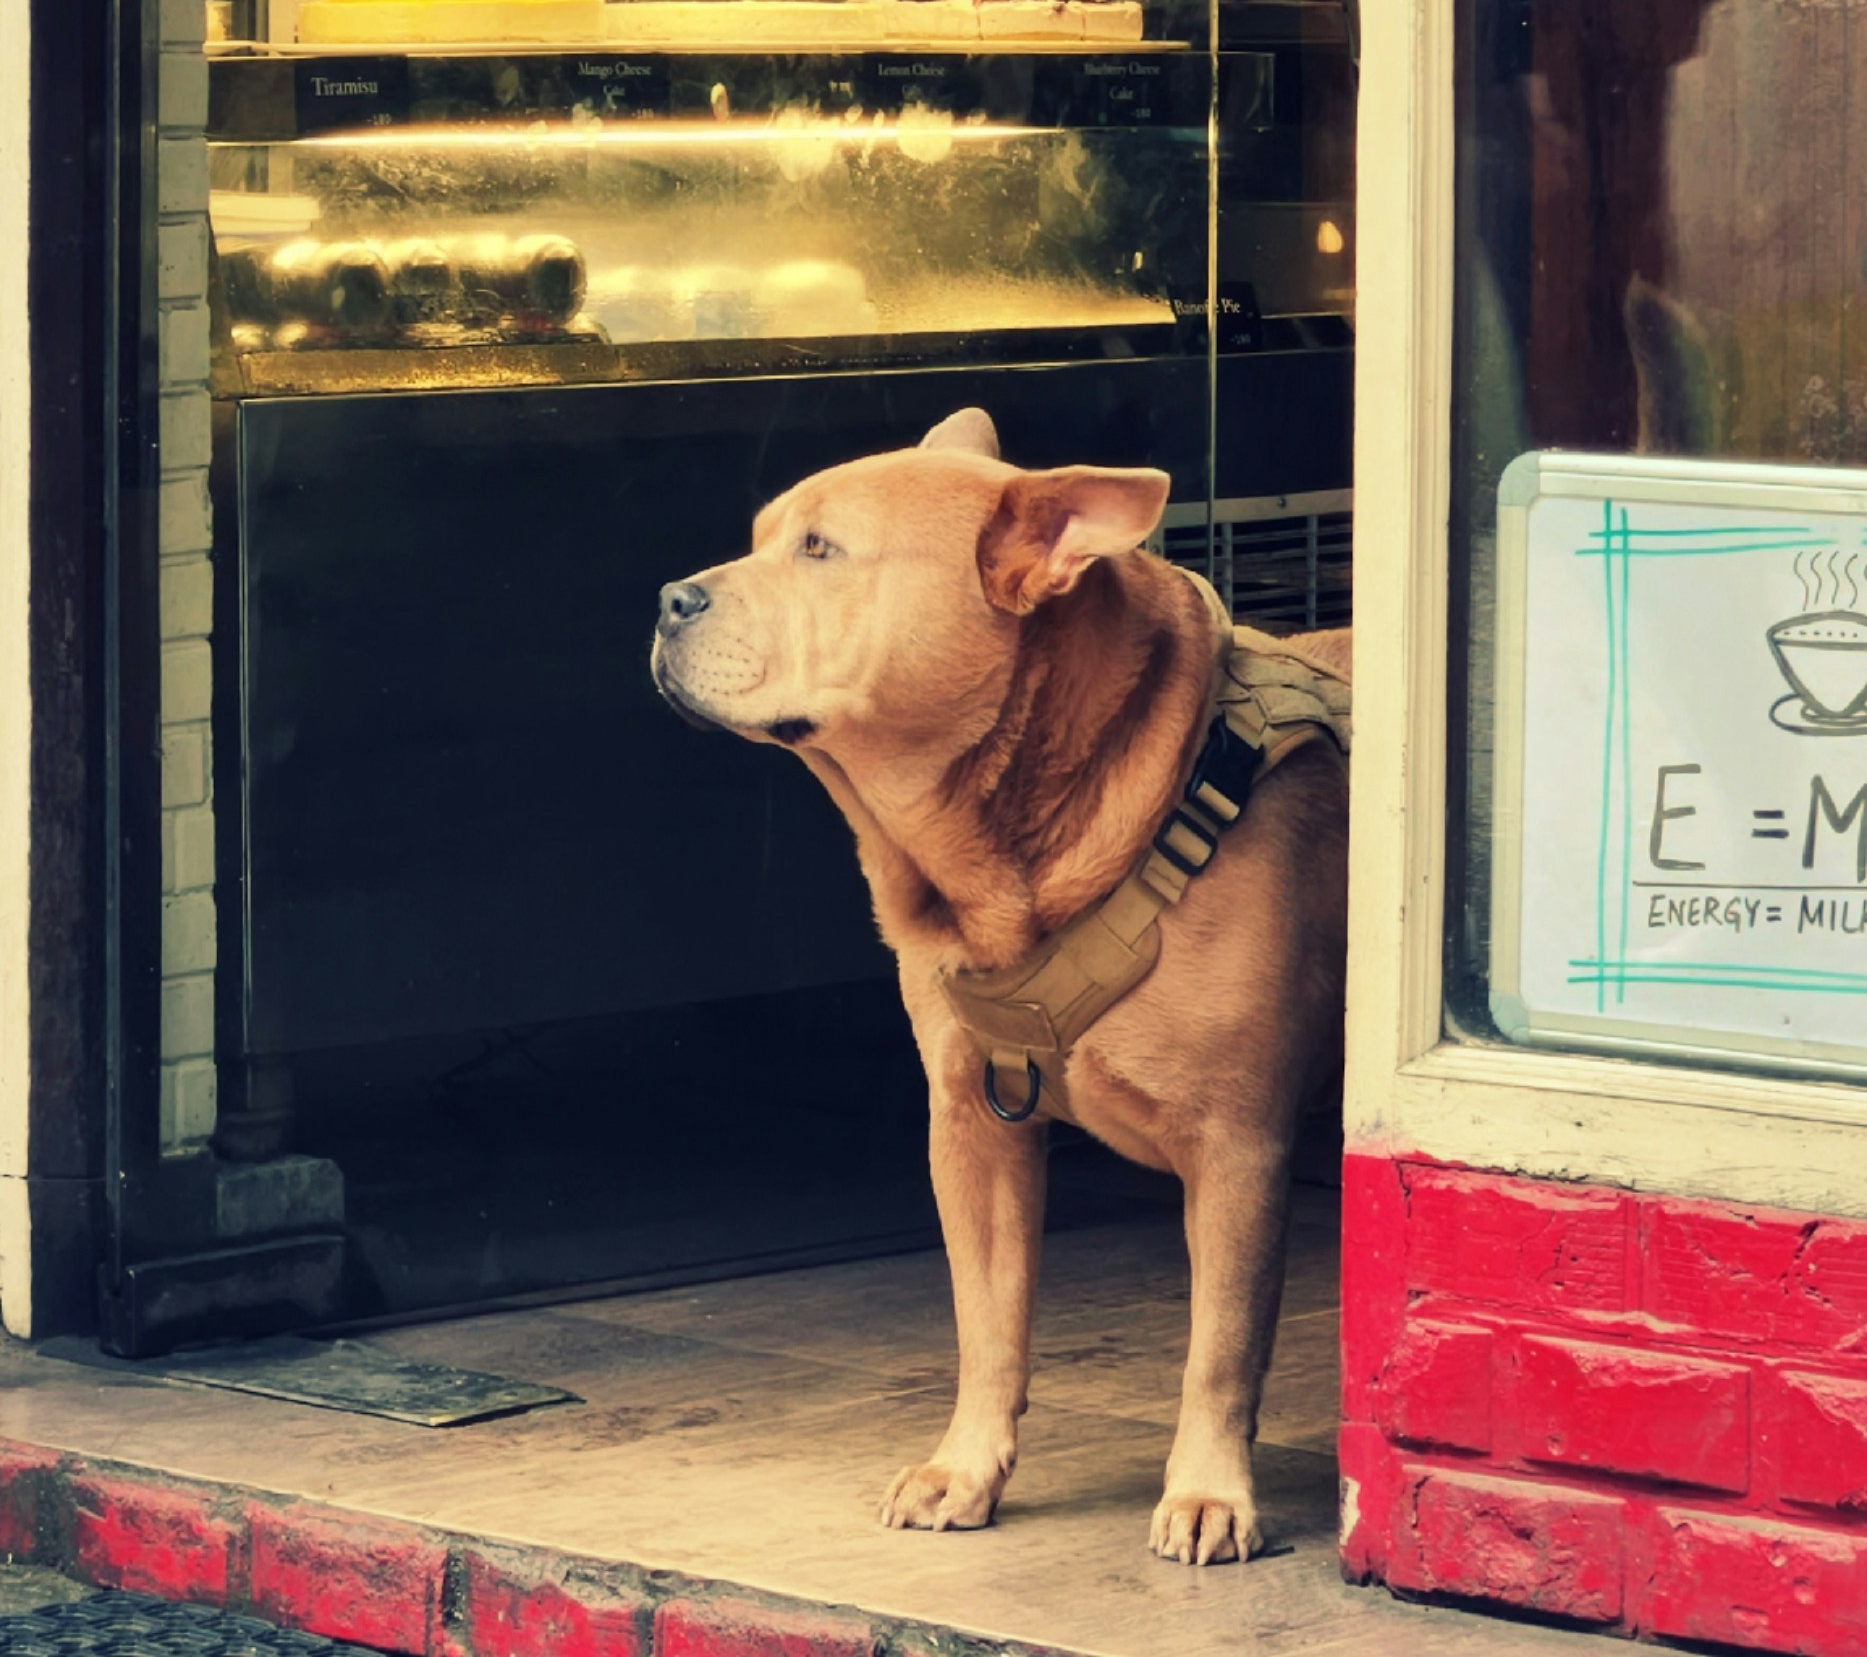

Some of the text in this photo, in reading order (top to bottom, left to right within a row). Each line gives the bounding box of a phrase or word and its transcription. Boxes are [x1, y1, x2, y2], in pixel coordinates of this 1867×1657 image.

[577, 61, 652, 80] Mango Cheese
[877, 62, 910, 77] Lemon
[310, 76, 379, 97] Tiramisu
[1220, 297, 1241, 314] Pie
[1649, 763, 1707, 871] E
